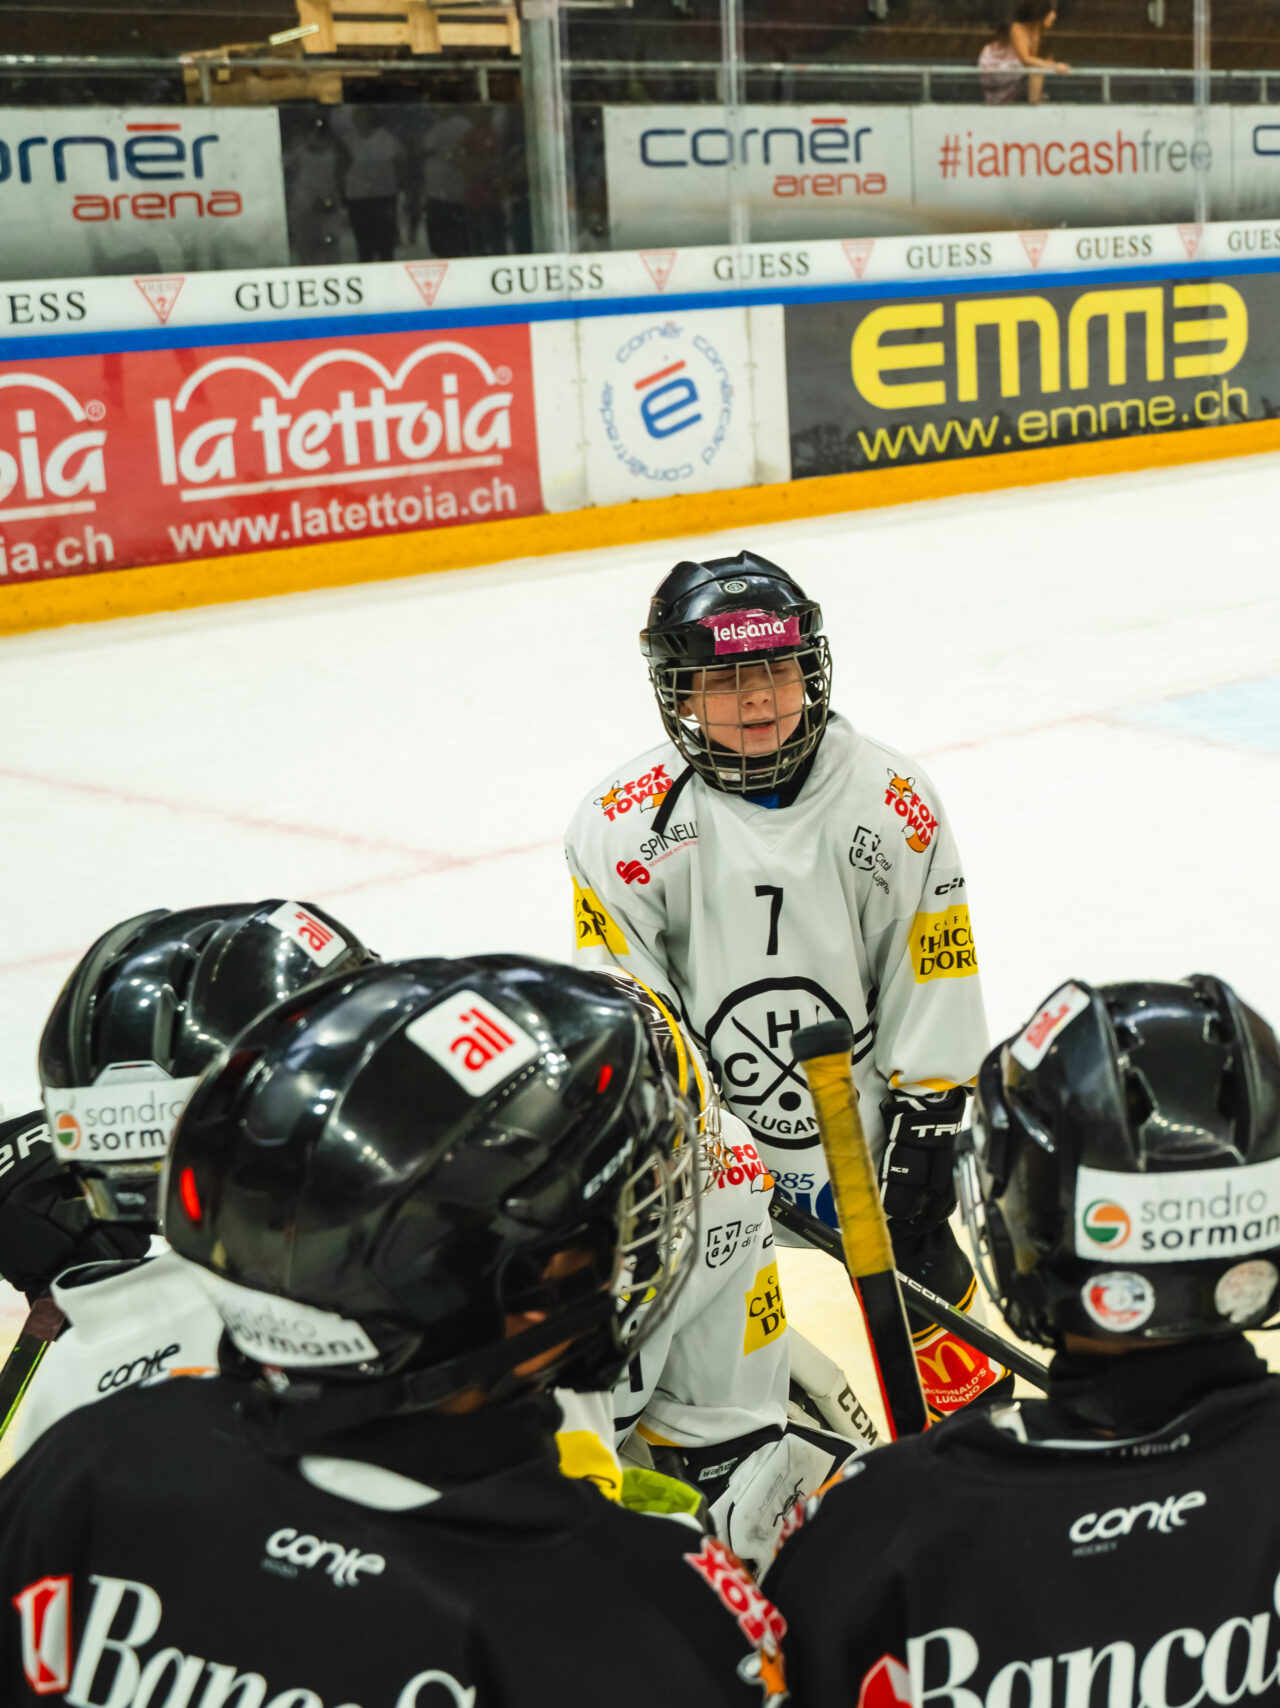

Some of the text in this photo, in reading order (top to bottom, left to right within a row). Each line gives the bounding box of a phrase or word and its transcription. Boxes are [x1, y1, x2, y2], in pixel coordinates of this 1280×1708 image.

[939, 129, 1212, 180] #iamcashfree
[72, 190, 243, 222] arena
[773, 171, 887, 198] arena
[714, 251, 811, 284] GUESS
[906, 242, 993, 271] GUESS
[1075, 235, 1154, 261] GUESS
[234, 276, 365, 312] GUESS
[491, 264, 605, 296] GUESS
[154, 373, 515, 487] la tettoia
[857, 379, 1248, 463] www.emme.ch
[168, 476, 517, 554] www.latettoia.ch
[603, 777, 674, 823] TOWN
[623, 764, 670, 795] FOX
[884, 788, 932, 844] TOWN
[910, 792, 940, 836] FOX
[754, 884, 785, 957] 7
[449, 1006, 516, 1073] ail
[87, 1127, 170, 1152] sorm
[747, 1109, 819, 1135] LUGAN
[731, 1143, 759, 1164] FO
[769, 1169, 816, 1191] 985
[1140, 1179, 1269, 1227] sandro
[97, 1341, 183, 1395] conte
[837, 1383, 880, 1446] CCM
[935, 1384, 981, 1405] LUGANO
[1069, 1490, 1207, 1544] conte
[265, 1527, 386, 1588] conte
